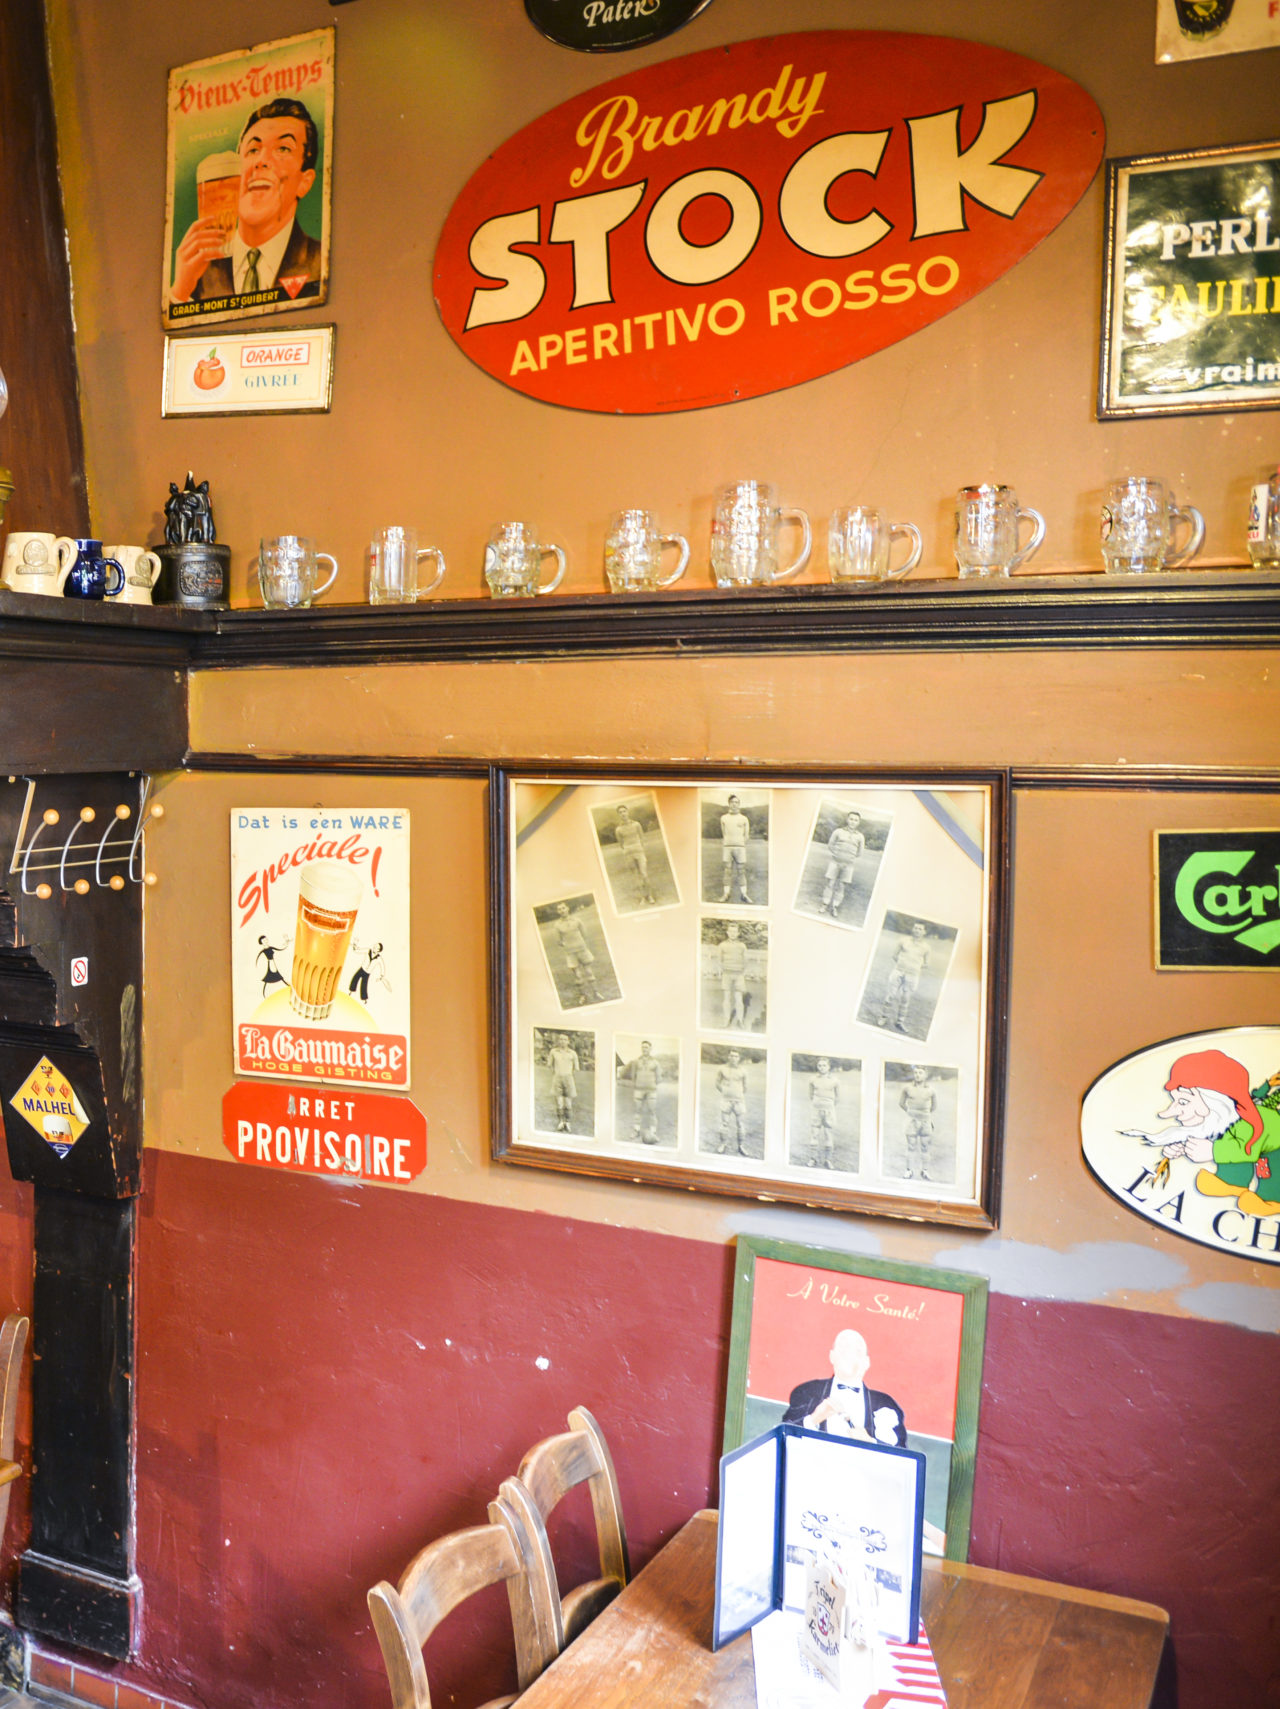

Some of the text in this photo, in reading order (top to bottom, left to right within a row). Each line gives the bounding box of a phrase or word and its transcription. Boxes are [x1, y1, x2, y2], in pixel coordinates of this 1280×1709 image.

[176, 58, 325, 115] Vieux-Temps
[568, 63, 828, 188] Brandy
[463, 87, 1047, 333] STOCK
[1160, 214, 1280, 261] PERL
[241, 290, 280, 308] GUIBERT
[509, 255, 960, 376] APERITIVO ROSSO
[245, 346, 304, 364] ORANGE
[1182, 356, 1280, 386] vraim
[238, 815, 403, 830] Dat is een WARE
[1175, 850, 1280, 934] Car
[252, 1060, 393, 1081] HOGE GISTING
[272, 1029, 405, 1072] Gaumaise
[288, 1093, 356, 1122] ARRET
[237, 1119, 412, 1179] PROVISOIRE
[1122, 1166, 1184, 1226] LA
[820, 1283, 860, 1311] Votre
[866, 1293, 926, 1322] Santé!
